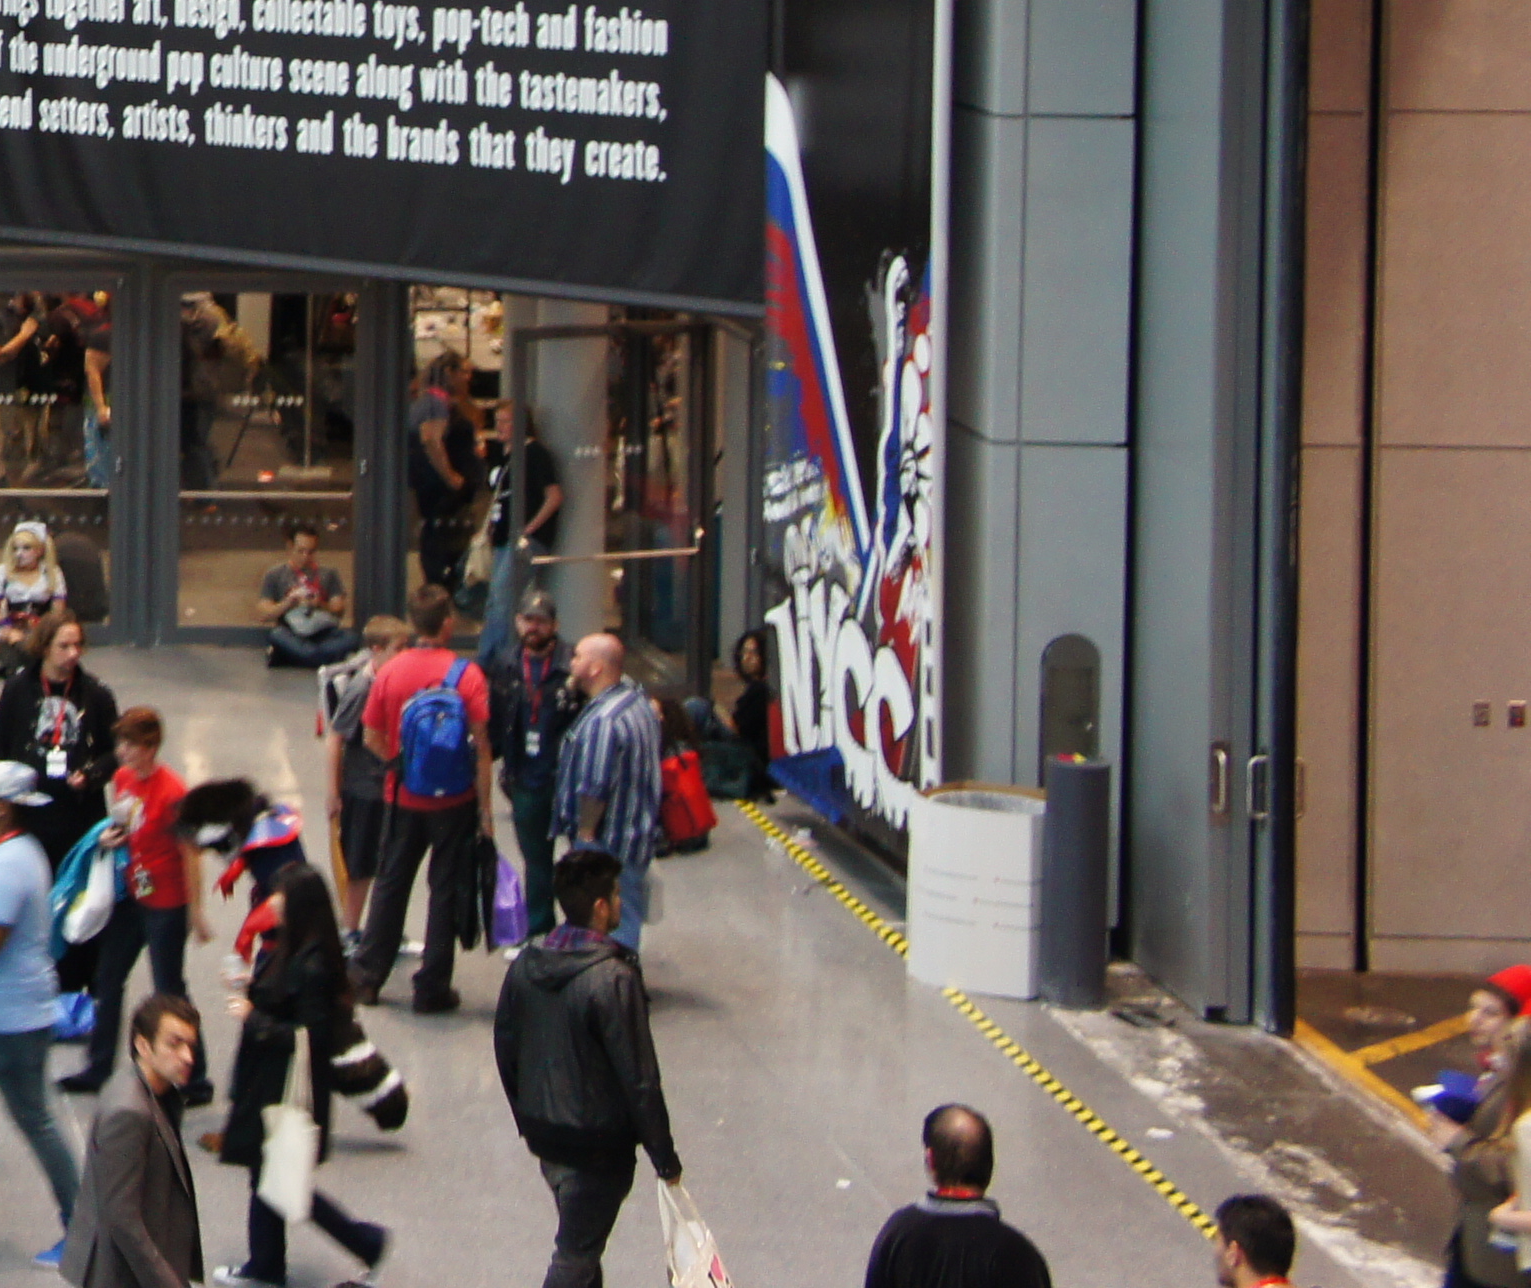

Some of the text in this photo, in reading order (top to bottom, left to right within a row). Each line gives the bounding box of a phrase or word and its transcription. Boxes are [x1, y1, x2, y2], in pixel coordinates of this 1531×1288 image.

[372, 0, 427, 51] toys,
[432, 0, 531, 55] pop-tech
[535, 3, 578, 51] and
[583, 4, 669, 56] fashion
[8, 30, 39, 75] the
[42, 34, 162, 90] underground
[166, 50, 205, 96] pop
[209, 44, 284, 92] culture
[288, 58, 351, 97] scene
[355, 52, 415, 112] along
[418, 58, 469, 105] with
[474, 60, 513, 109] the
[518, 68, 668, 124] tastemakers,
[38, 96, 115, 141] setters,
[122, 99, 197, 147] artists,
[203, 101, 289, 152] thinkers
[295, 110, 335, 155] and
[341, 112, 380, 160] the
[385, 114, 461, 166] brands
[468, 121, 517, 171] that
[524, 125, 577, 186] they
[584, 139, 668, 183] create.
[764, 574, 916, 830] NYCC
